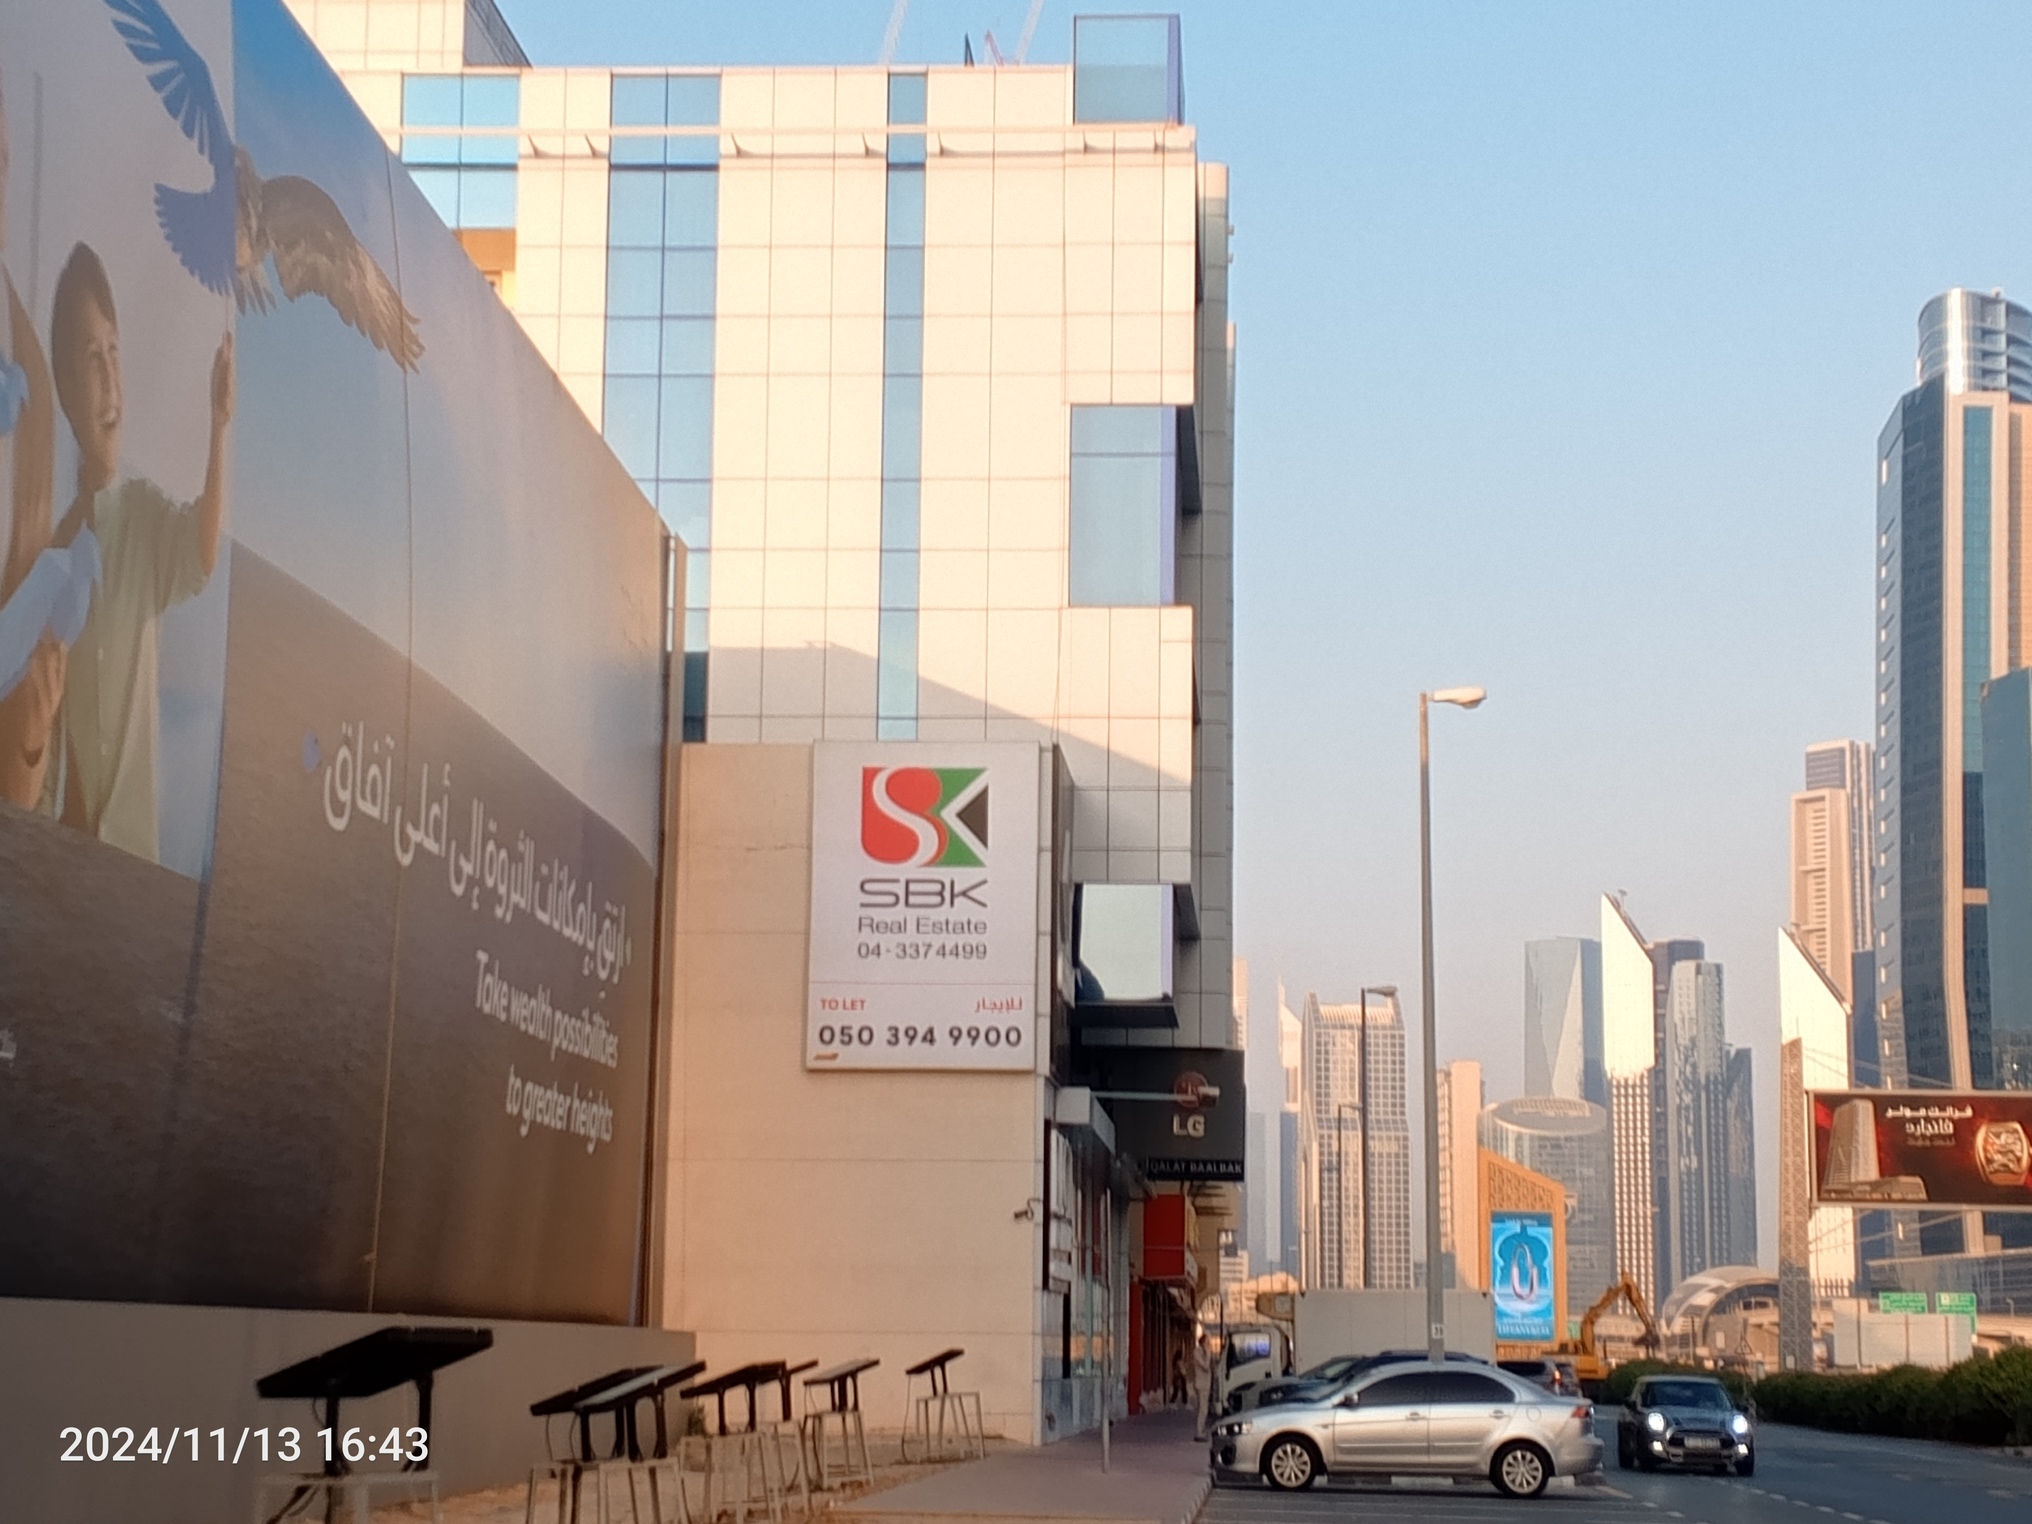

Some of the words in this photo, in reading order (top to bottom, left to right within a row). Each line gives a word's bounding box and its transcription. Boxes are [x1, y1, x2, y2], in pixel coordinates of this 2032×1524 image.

[394, 762, 450, 866] أعلى
[450, 798, 484, 911] إلى
[484, 818, 535, 924] الثروة
[859, 878, 988, 909] SBK
[858, 916, 907, 935] Real
[916, 916, 988, 935] Estate
[475, 949, 509, 1022] Take
[510, 983, 552, 1041] wealth
[551, 1006, 618, 1069] possibilities
[820, 998, 839, 1011] TO
[842, 998, 867, 1011] LET
[819, 1025, 875, 1046] 050
[886, 1026, 937, 1046] 394
[949, 1026, 1022, 1047] 9900
[506, 1063, 522, 1117] to
[520, 1080, 572, 1138] greater
[570, 1081, 613, 1155] heights
[1173, 1114, 1205, 1137] LG
